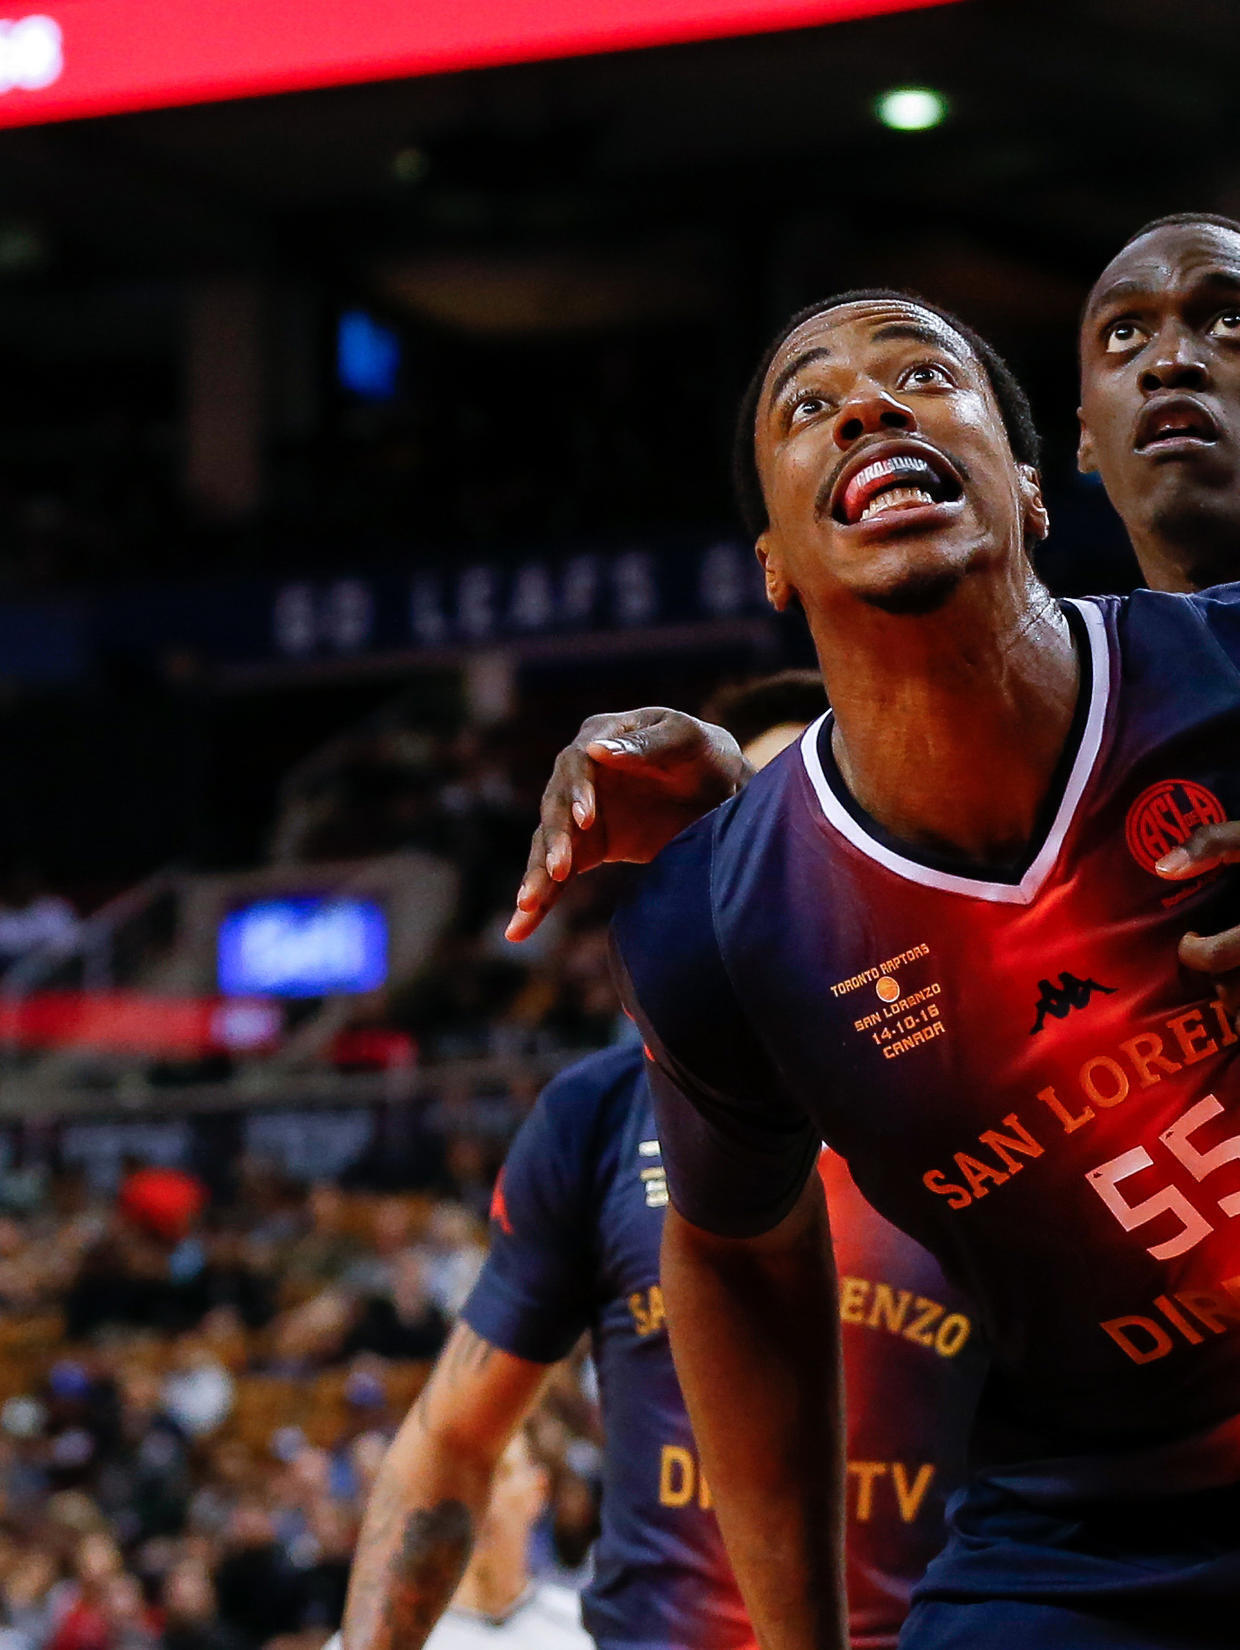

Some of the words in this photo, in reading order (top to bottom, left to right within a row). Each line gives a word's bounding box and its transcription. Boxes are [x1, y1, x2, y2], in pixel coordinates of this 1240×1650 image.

[830, 967, 880, 998] TORONTO
[879, 943, 930, 975] RAPTORS
[854, 1012, 882, 1031] SAN
[882, 983, 941, 1018] LORENZO
[882, 1021, 945, 1059] CANADA
[922, 1112, 1045, 1210] SAN
